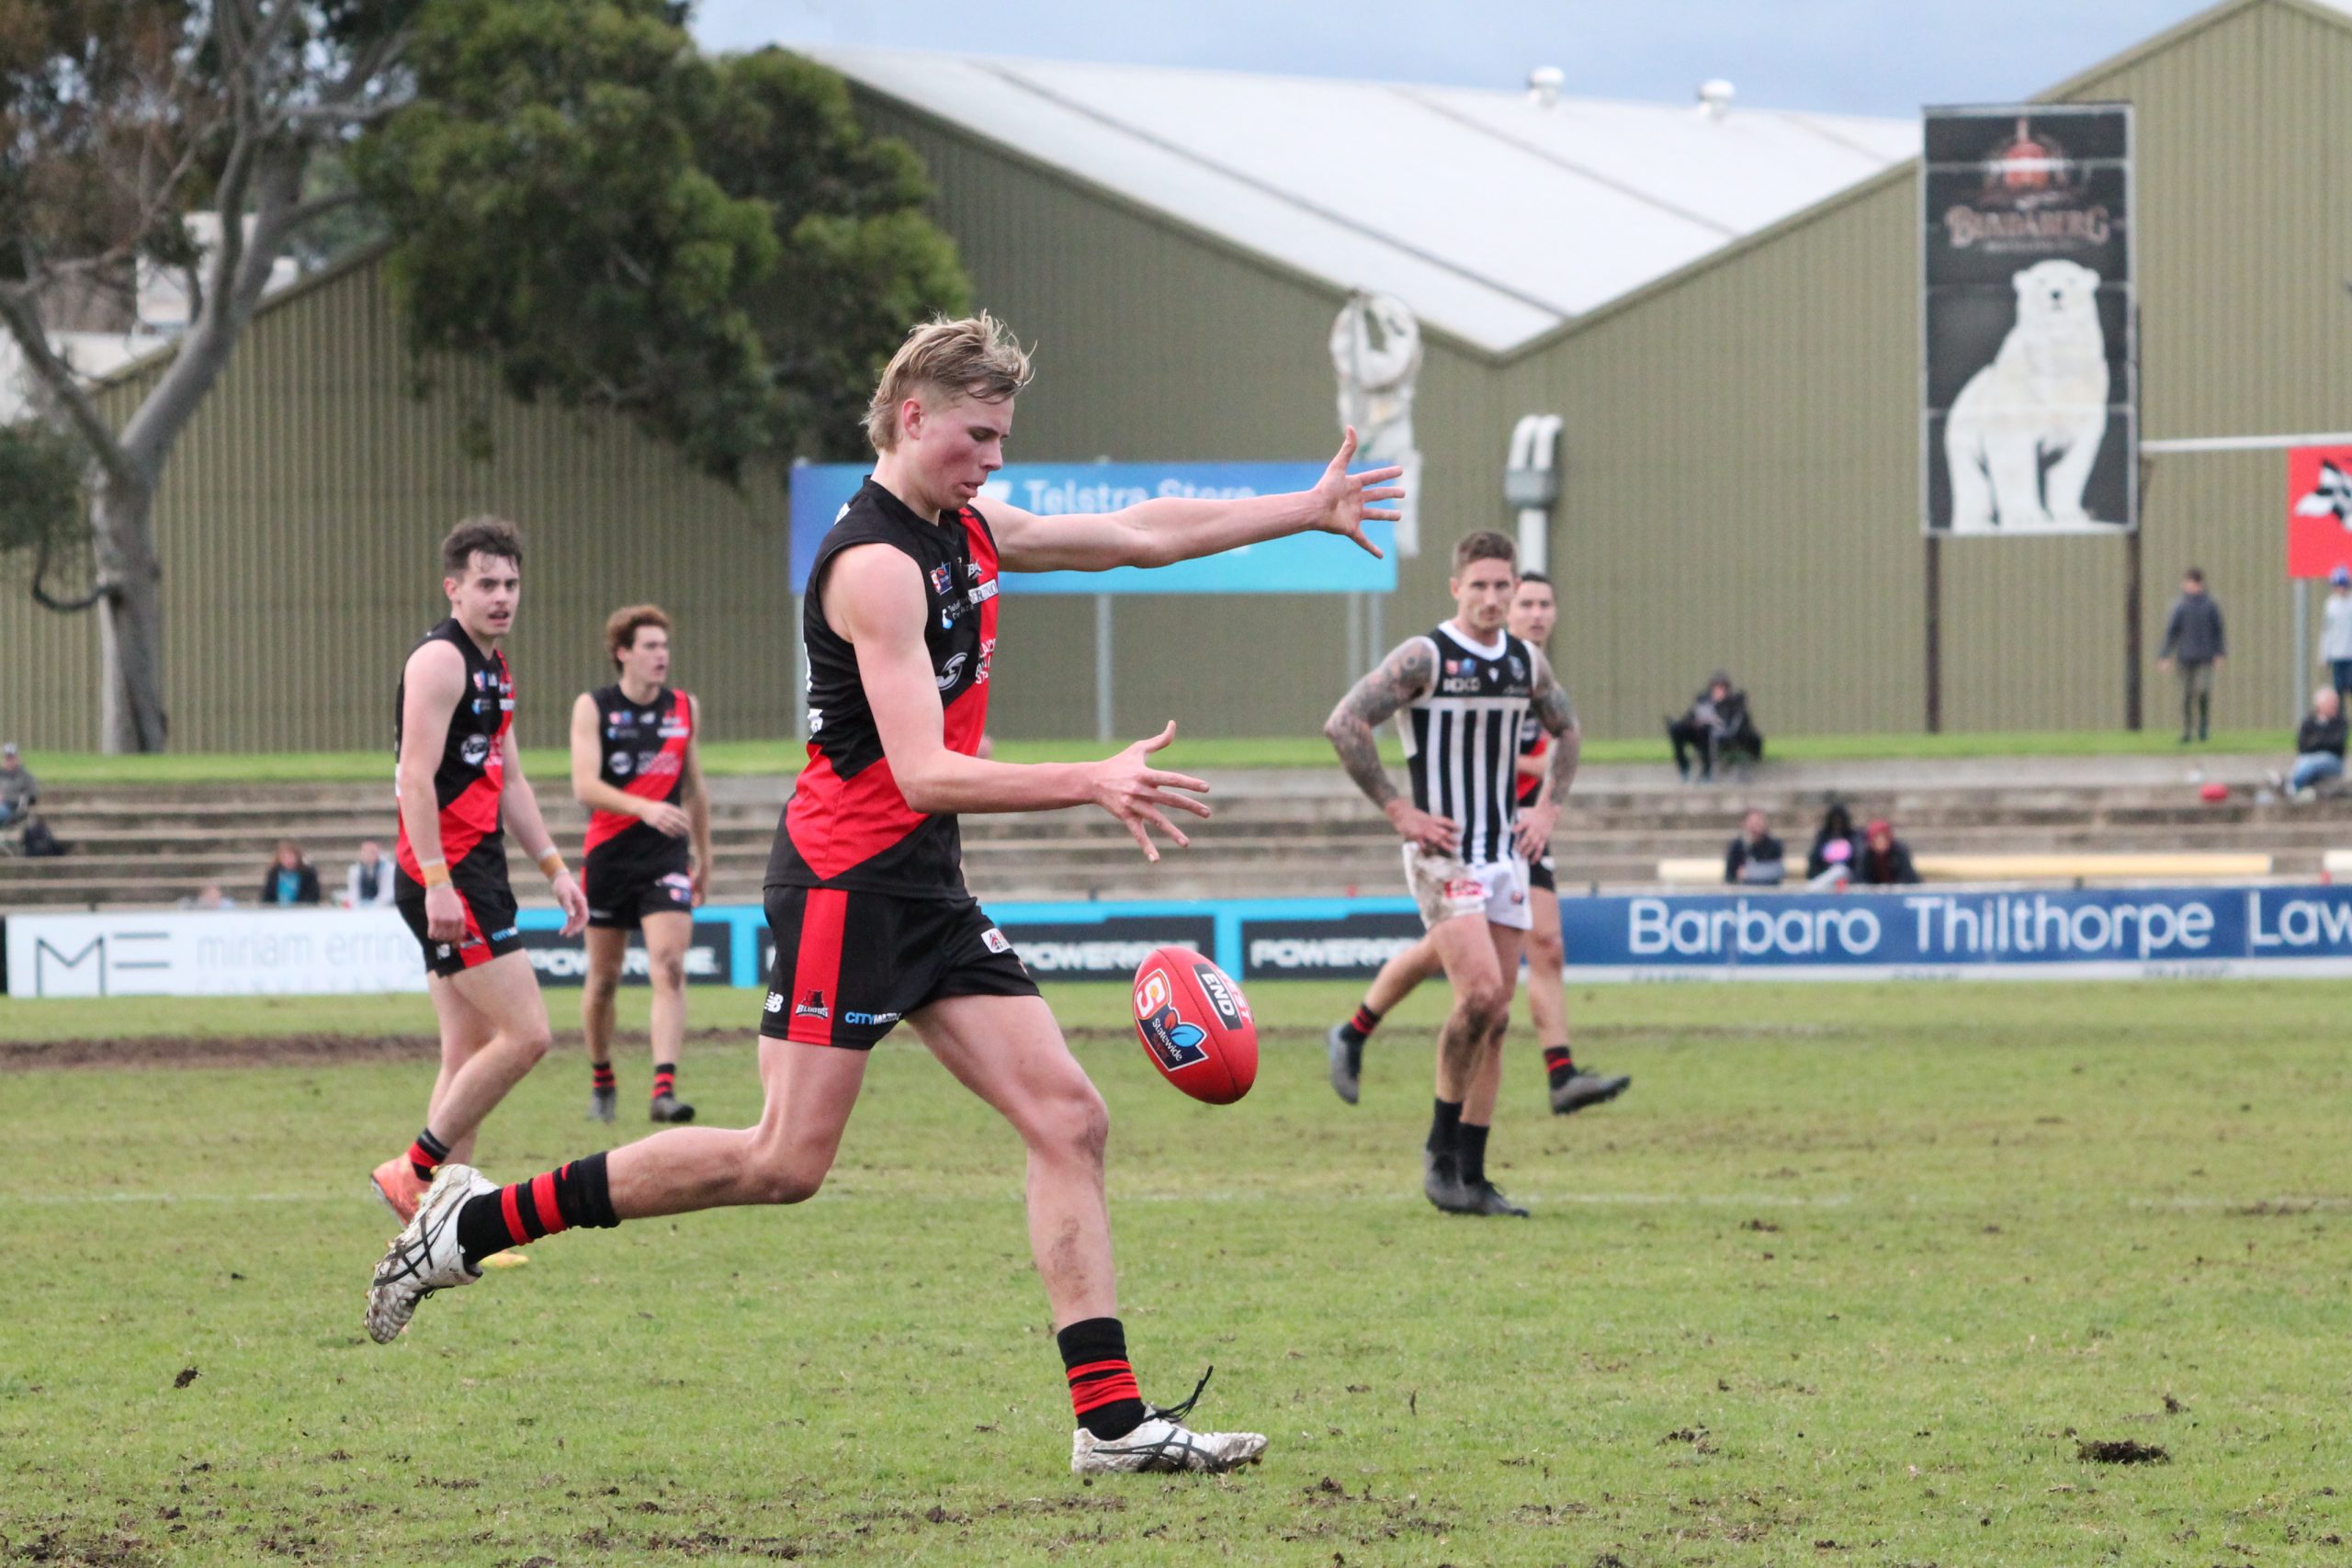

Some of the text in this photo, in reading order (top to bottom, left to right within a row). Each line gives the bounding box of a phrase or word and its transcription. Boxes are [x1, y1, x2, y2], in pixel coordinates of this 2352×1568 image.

[1024, 479, 1149, 514] Telstra
[1628, 889, 2352, 960] Barbaro Thilthorpe Law
[197, 930, 313, 965] miriam
[1250, 937, 1422, 968] POWER
[1201, 973, 1237, 1016] END
[1151, 1018, 1183, 1062] Statewide
